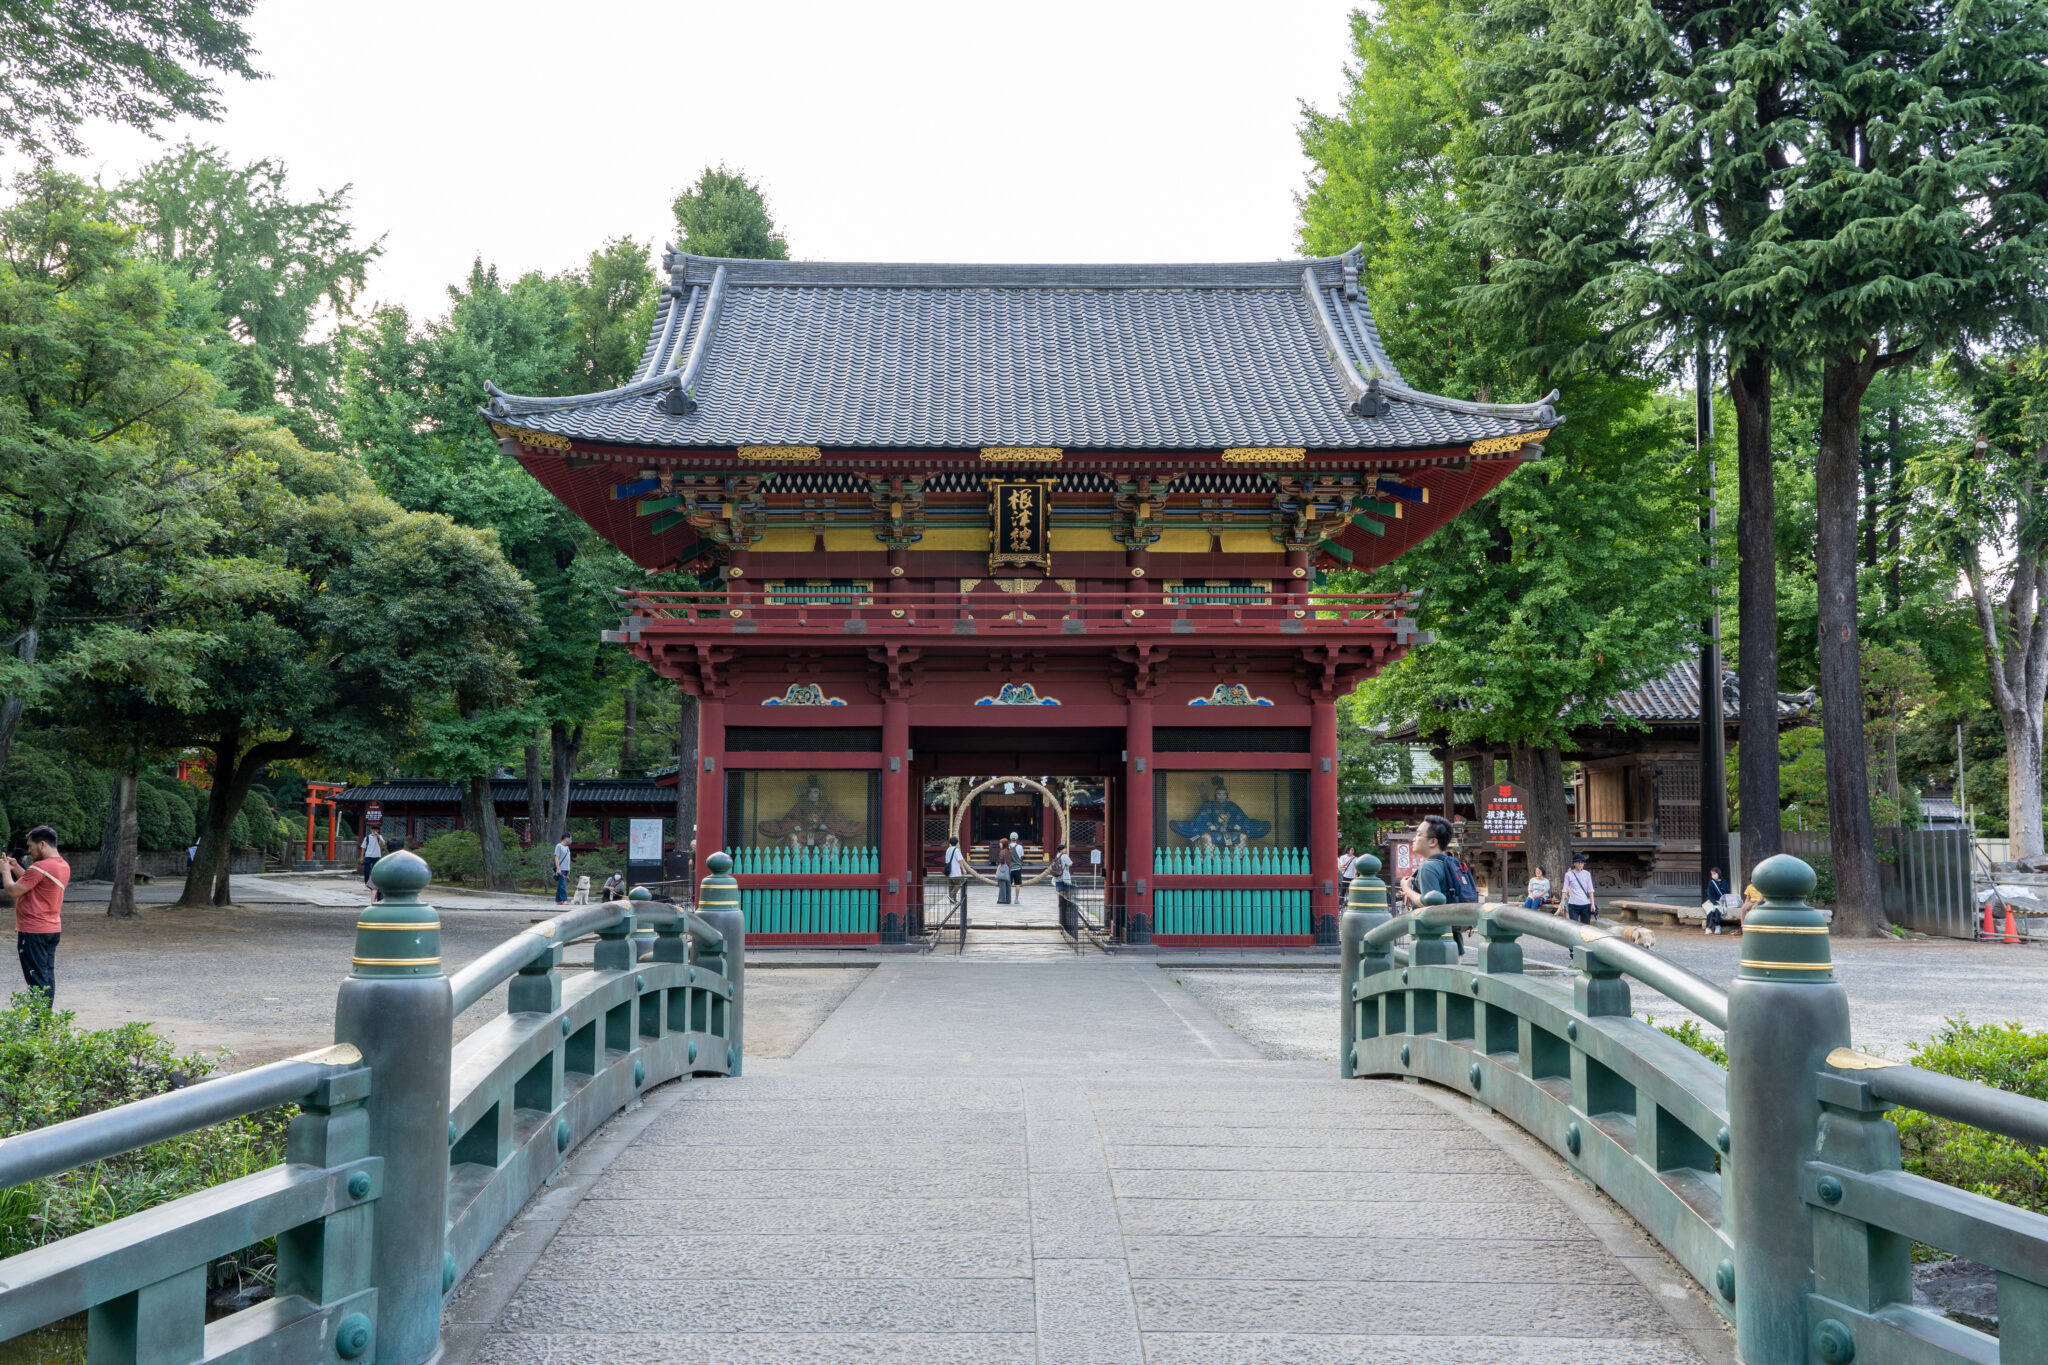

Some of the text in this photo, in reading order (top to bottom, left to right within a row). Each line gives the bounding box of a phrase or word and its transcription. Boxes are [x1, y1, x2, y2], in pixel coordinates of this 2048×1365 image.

[1008, 488, 1033, 552] 根津神社
[1487, 810, 1525, 819] 根津神社
